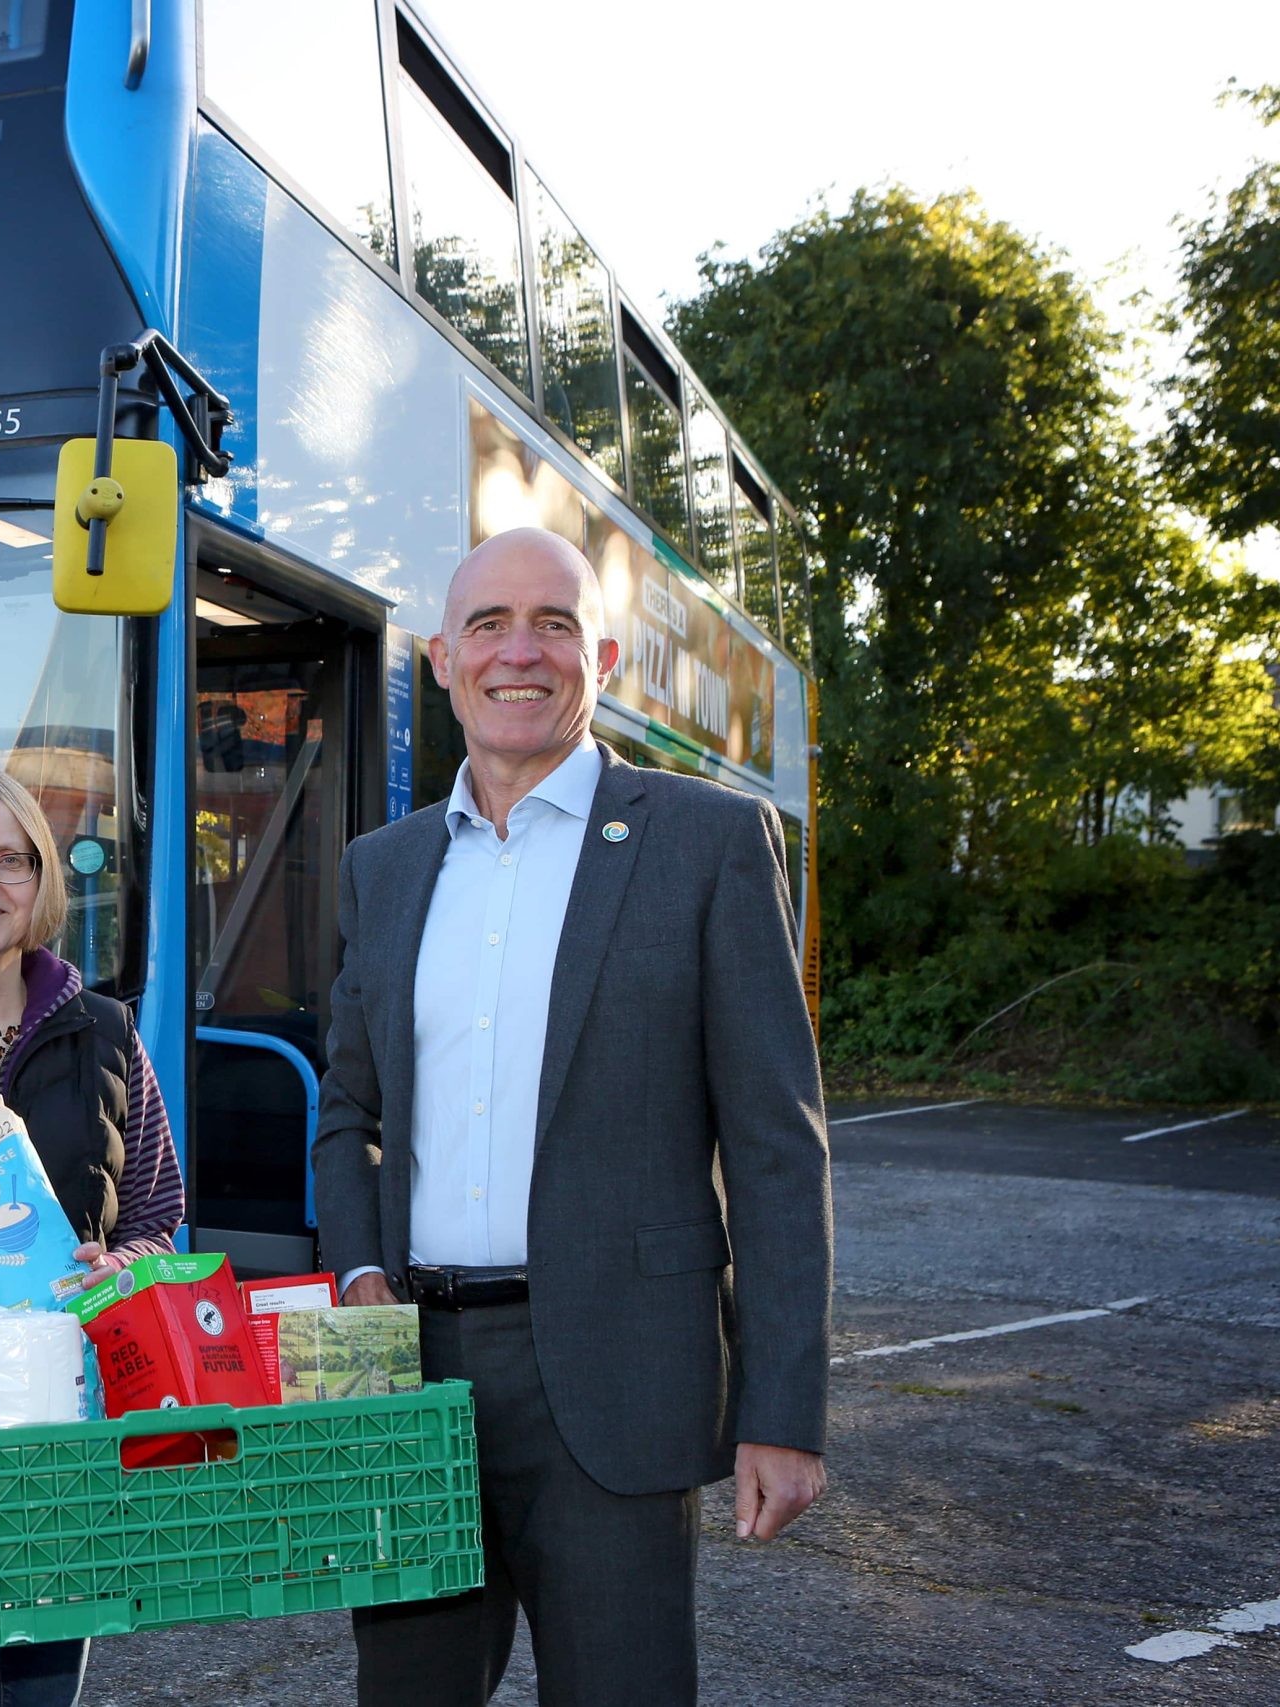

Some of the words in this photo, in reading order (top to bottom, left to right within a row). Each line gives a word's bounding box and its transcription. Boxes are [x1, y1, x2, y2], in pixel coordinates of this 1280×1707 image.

[633, 613, 674, 710] PIZZA
[694, 658, 728, 740] TOWN
[111, 1341, 138, 1365] RED
[199, 1344, 239, 1354] SUPPORTING
[107, 1352, 155, 1386] LABEL
[203, 1360, 246, 1373] FUTURE
